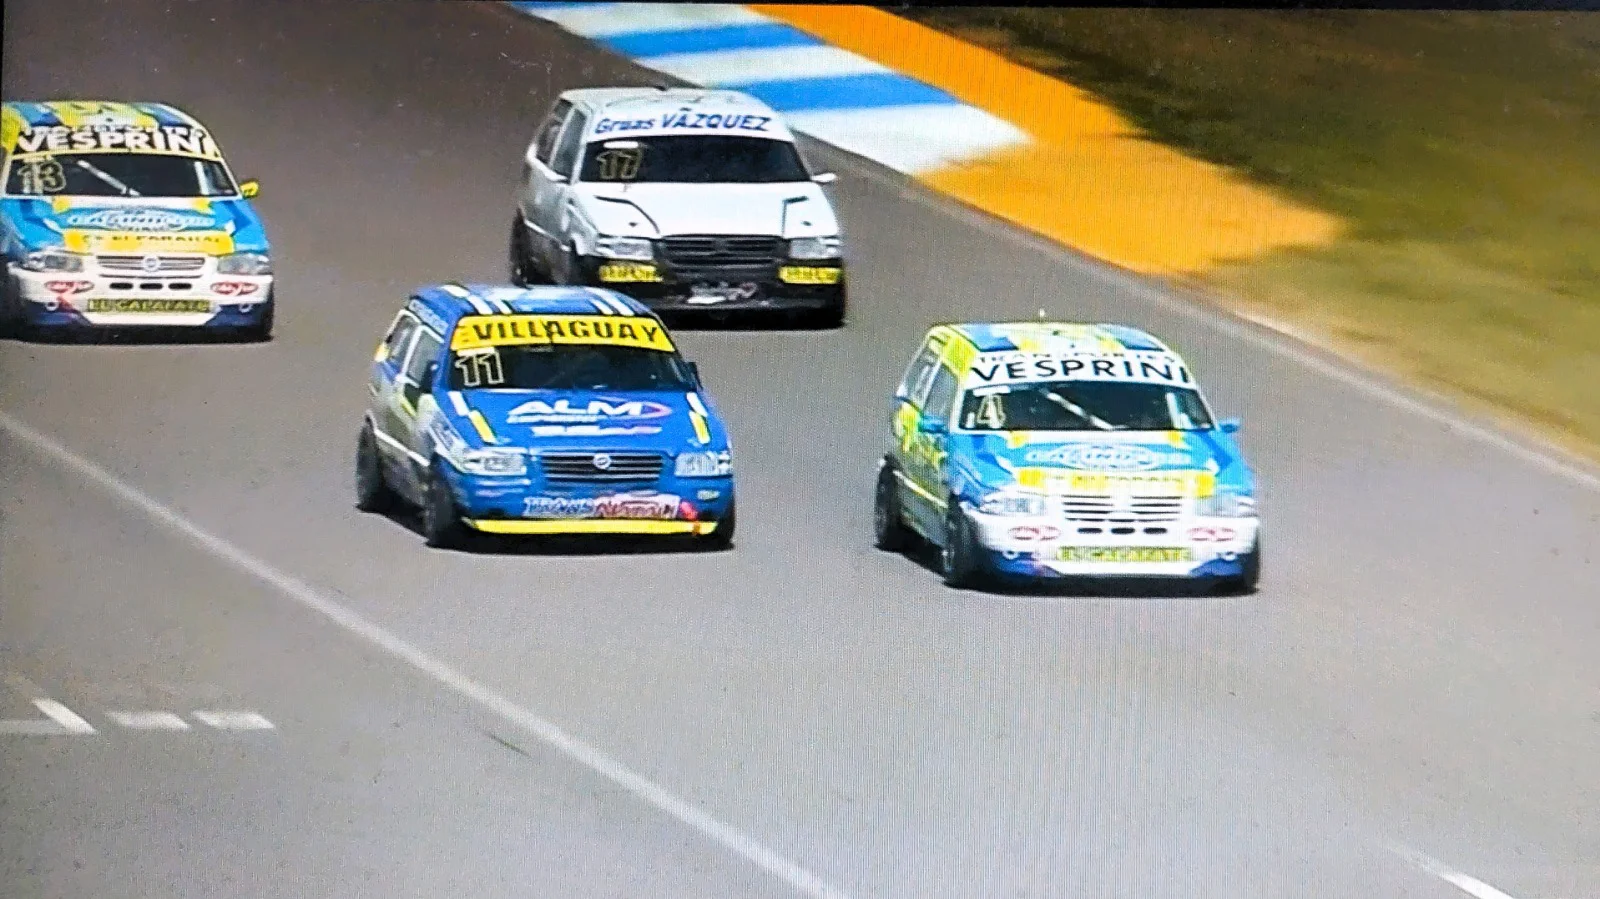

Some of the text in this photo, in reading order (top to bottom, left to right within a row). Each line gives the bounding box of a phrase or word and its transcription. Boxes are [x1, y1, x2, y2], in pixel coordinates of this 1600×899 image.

[17, 130, 221, 158] VESPRINI
[17, 158, 67, 194] 13
[597, 150, 643, 180] 17
[473, 319, 658, 343] VILLAGUAY
[455, 352, 504, 387] 11
[970, 359, 1190, 384] VESPRINI
[976, 394, 1007, 427] 4
